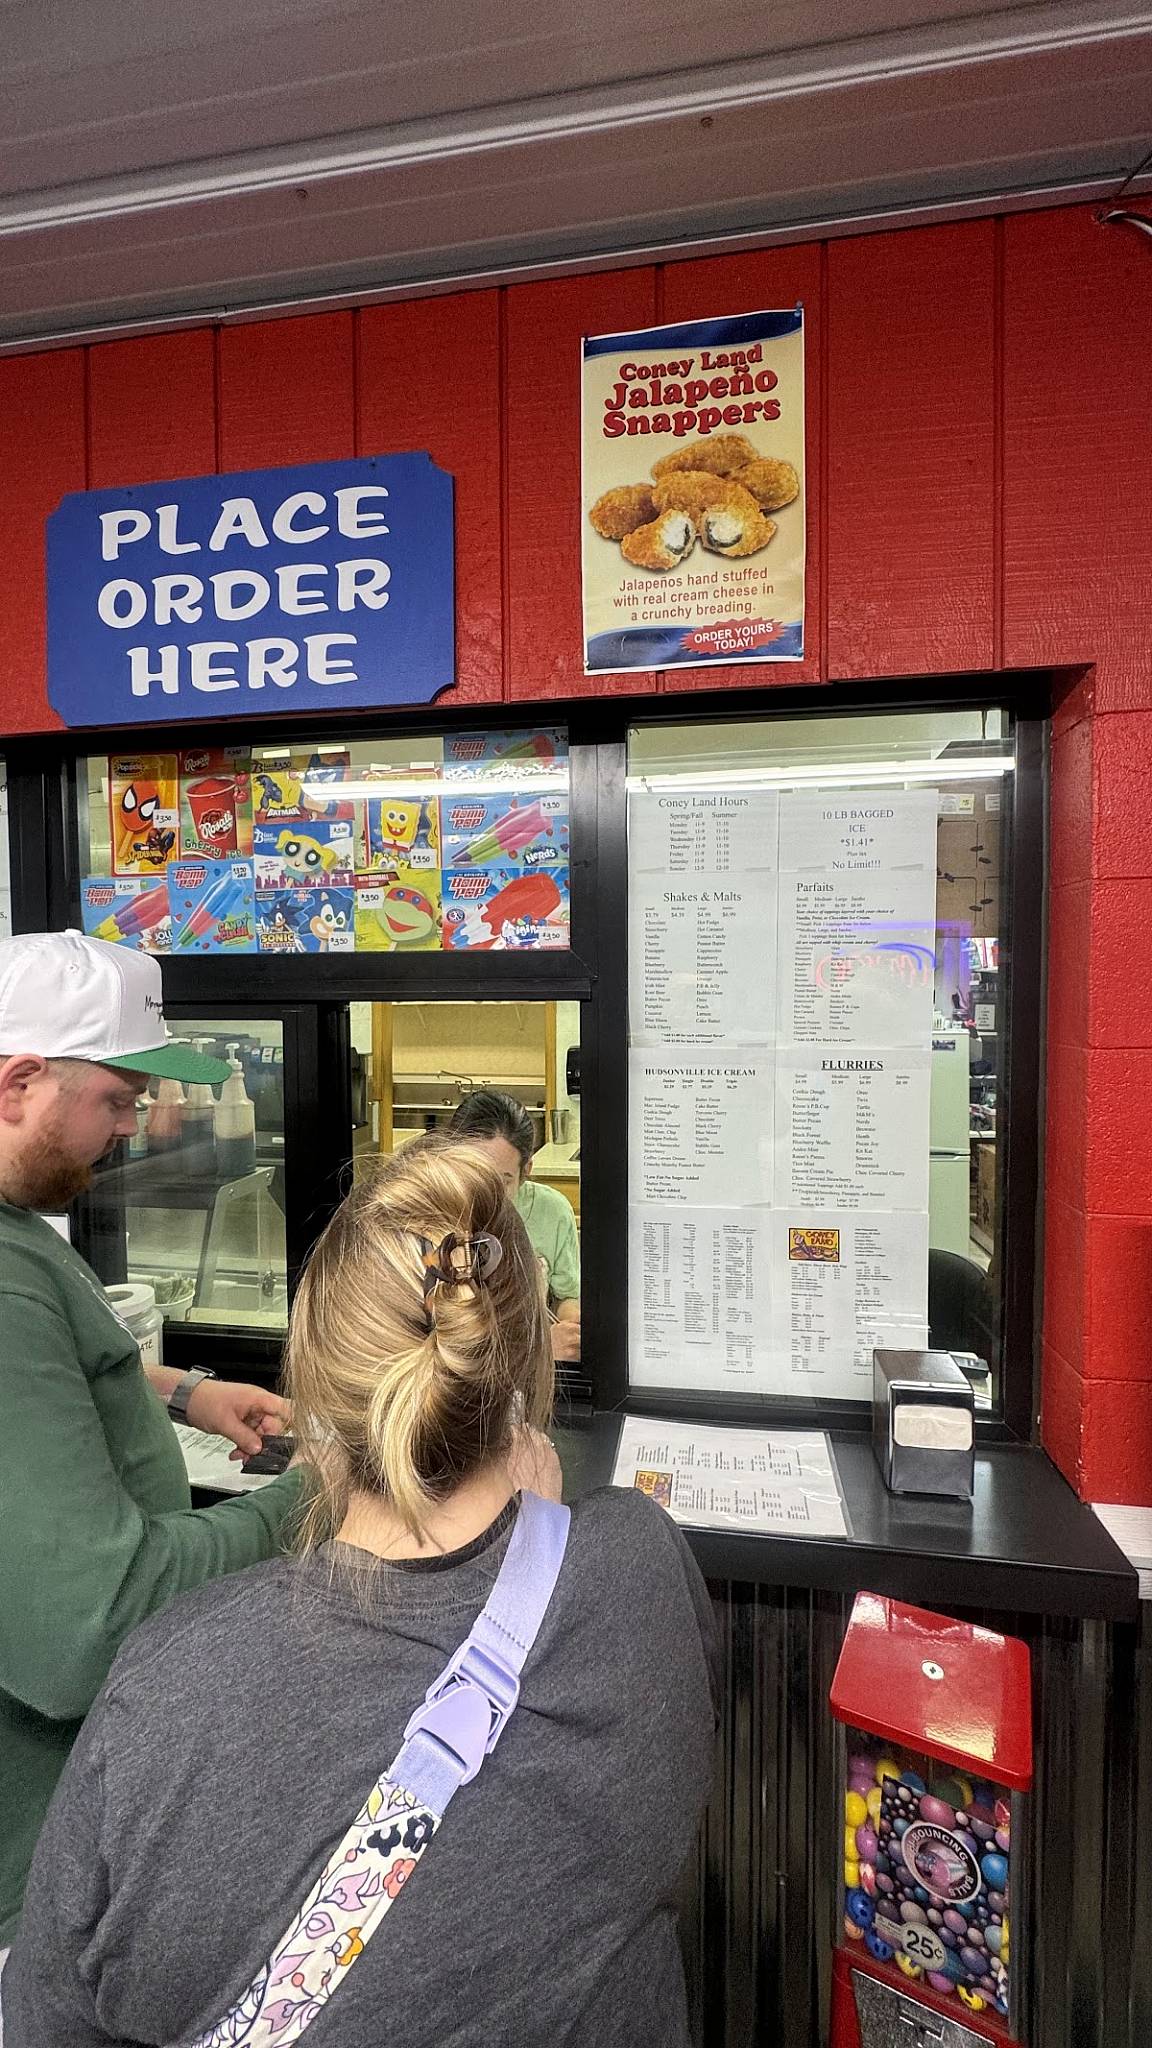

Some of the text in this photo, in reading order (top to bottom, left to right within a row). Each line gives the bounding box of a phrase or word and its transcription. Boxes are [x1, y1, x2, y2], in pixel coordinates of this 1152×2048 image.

[619, 344, 763, 382] Coney Land
[604, 365, 778, 411] Jalapeño
[603, 398, 781, 438] Snappers
[98, 485, 391, 561] PLACE
[619, 567, 768, 592] Jalapeños hand stuffed
[97, 558, 392, 629] ORDER
[613, 582, 774, 608] with real cream cheese in
[631, 601, 756, 621] a crunchy breading.
[694, 622, 773, 644] ORDER YOURS
[713, 637, 754, 651] TODAY!
[126, 633, 359, 697] HERE
[658, 796, 749, 810] Coney Land Hours
[823, 809, 894, 820] 10 LB BAGGED
[849, 824, 866, 833] ICE
[832, 859, 881, 869] No Limit!!!
[663, 891, 743, 903] Shakes & Malts
[796, 882, 835, 893] Parfaits
[260, 933, 295, 944] SONIC
[644, 1067, 756, 1077] HUDSONVILLE ICE CREAM
[821, 1059, 884, 1070] FLURRIES
[906, 1929, 943, 1960] 25¢
